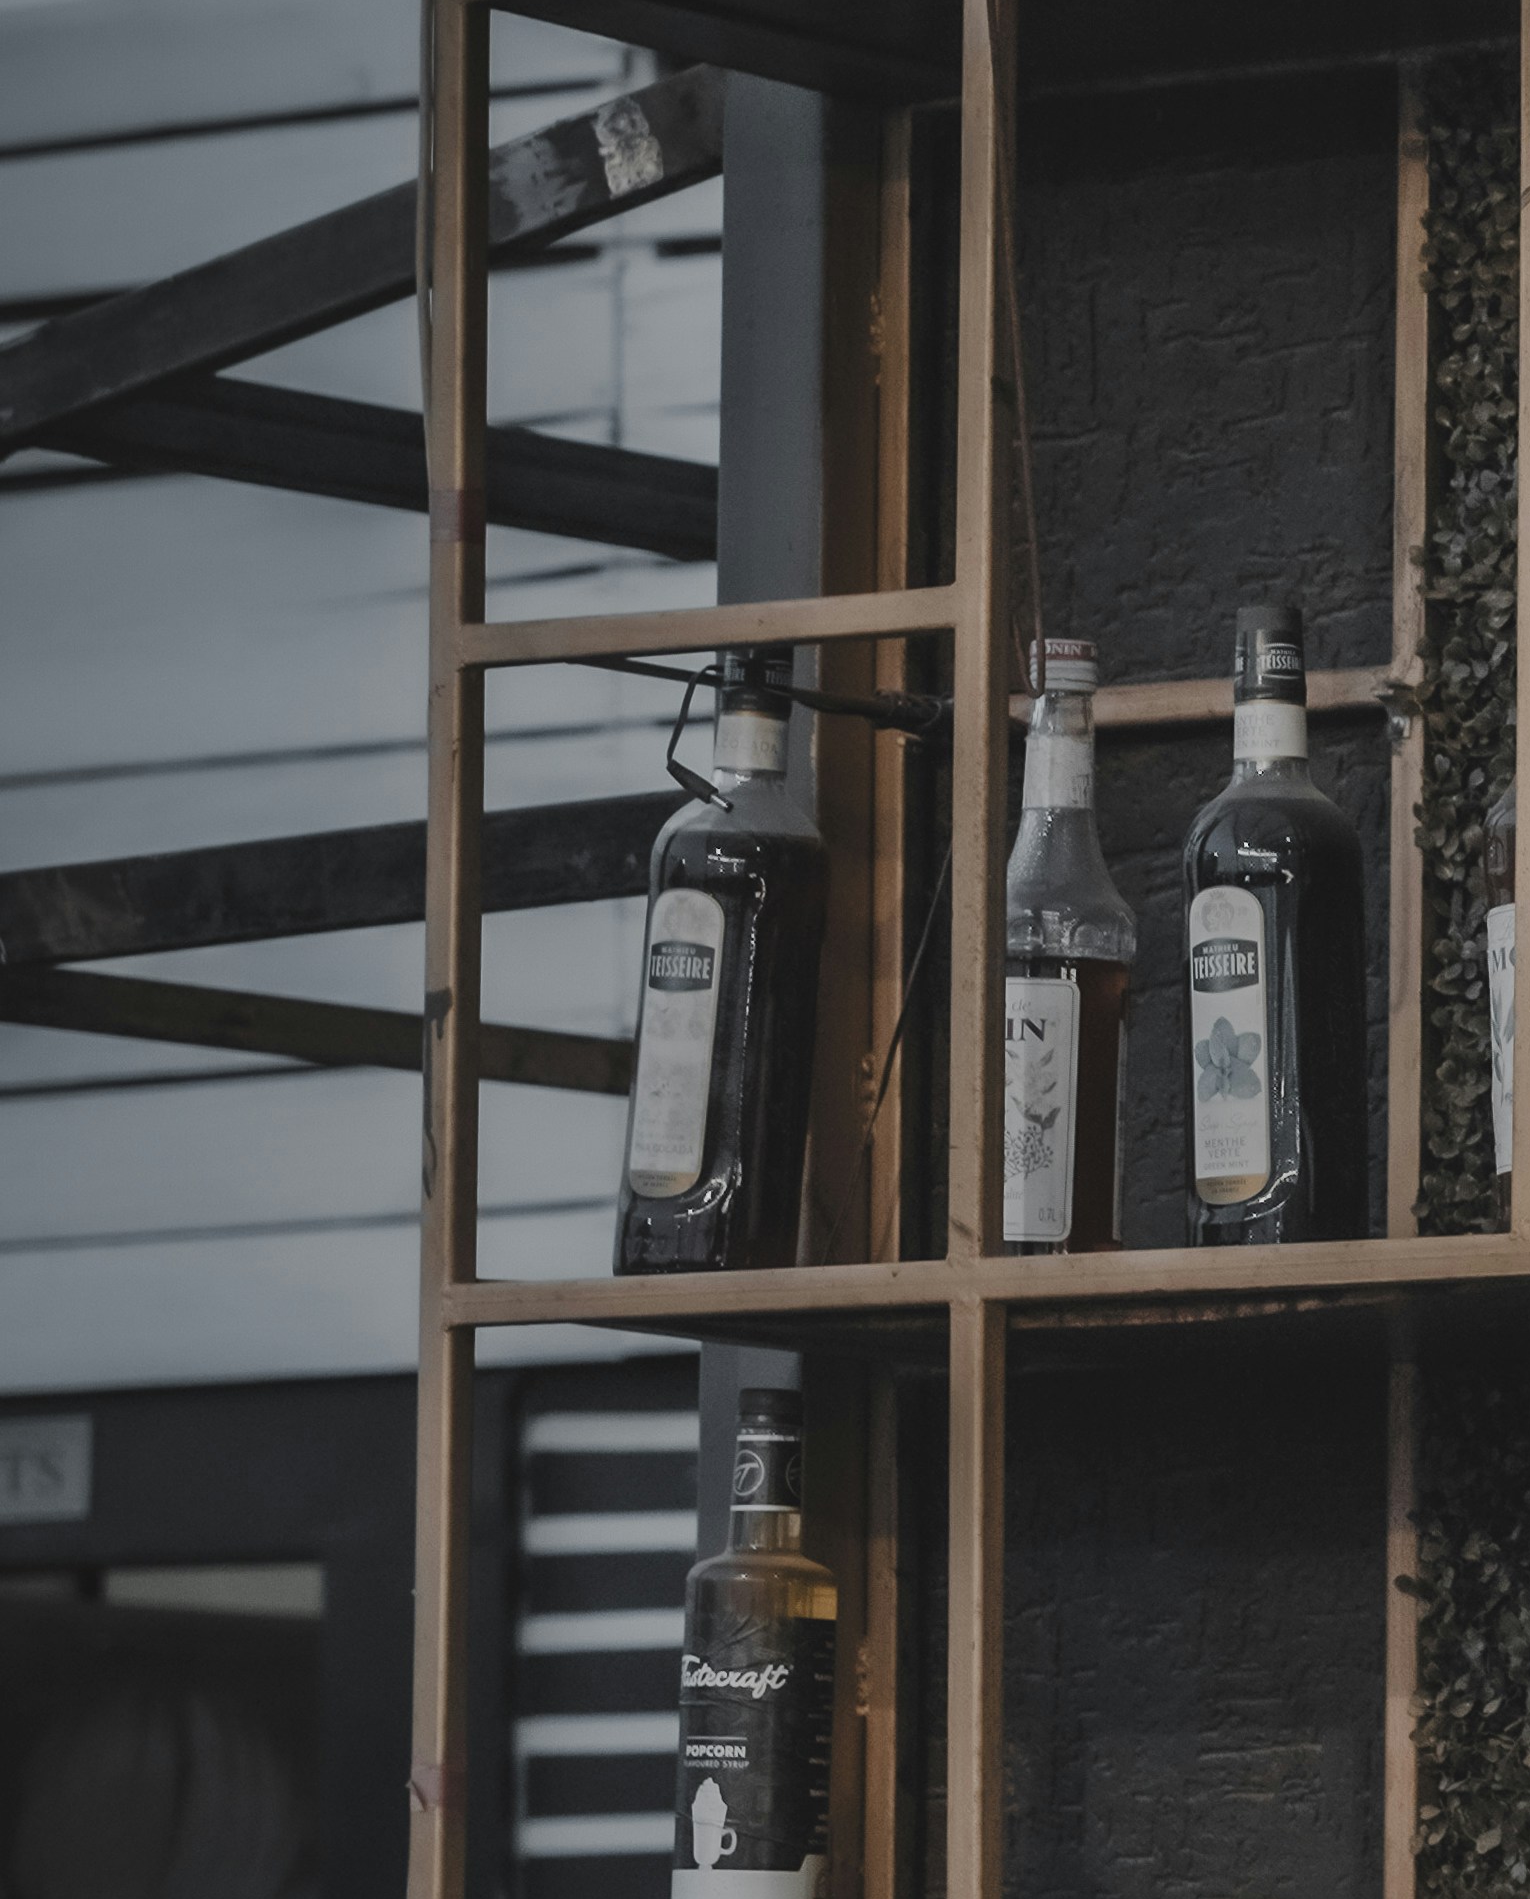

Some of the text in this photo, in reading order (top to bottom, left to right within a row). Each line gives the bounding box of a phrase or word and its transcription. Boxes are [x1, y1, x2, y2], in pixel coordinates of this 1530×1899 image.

[1202, 943, 1239, 953] MATHIEU
[651, 954, 712, 981] TEISSEIRE
[1194, 952, 1257, 980] TEISSEIRE
[685, 1743, 747, 1760] POPCORN
[722, 1760, 751, 1771] SYRUP
